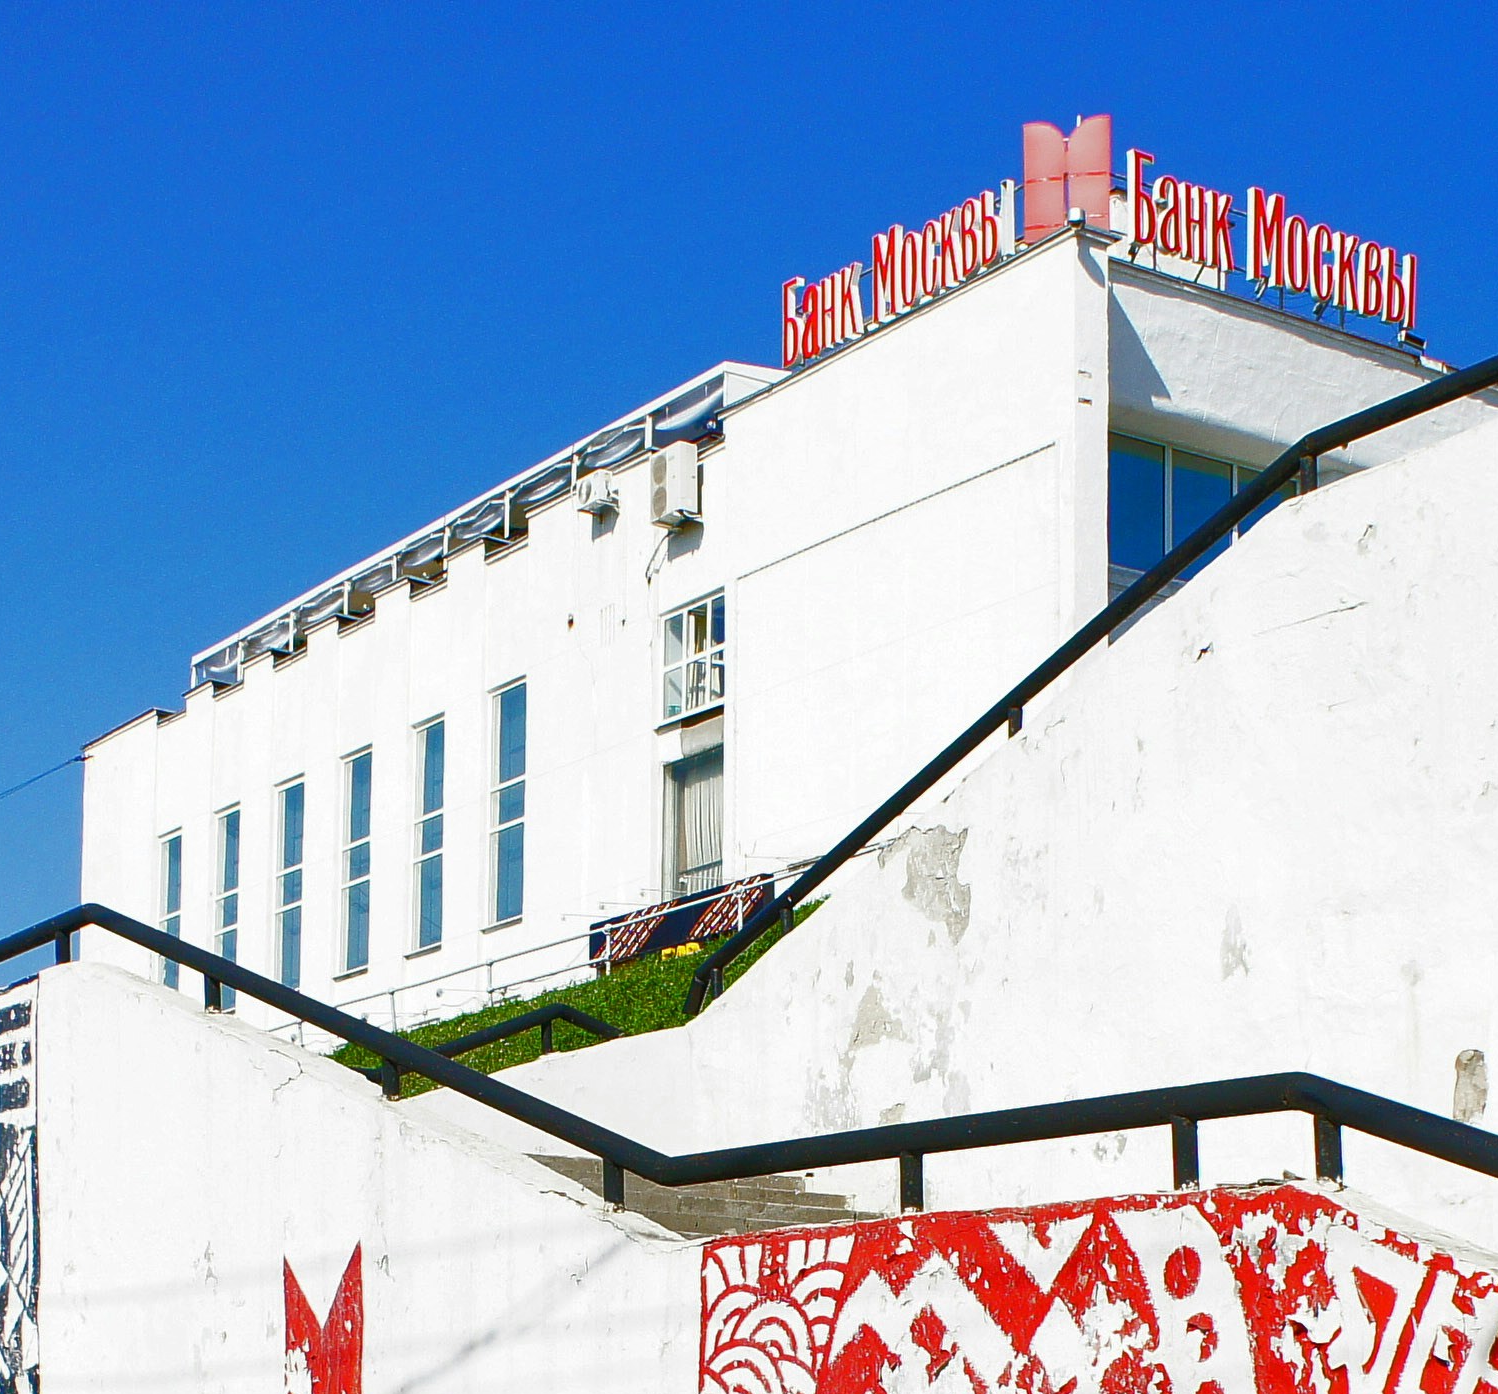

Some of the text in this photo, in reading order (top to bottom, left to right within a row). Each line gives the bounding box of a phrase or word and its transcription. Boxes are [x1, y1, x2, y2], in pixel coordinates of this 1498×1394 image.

[781, 179, 1015, 368] Банк Москвы
[1126, 148, 1417, 330] Банк Москвы
